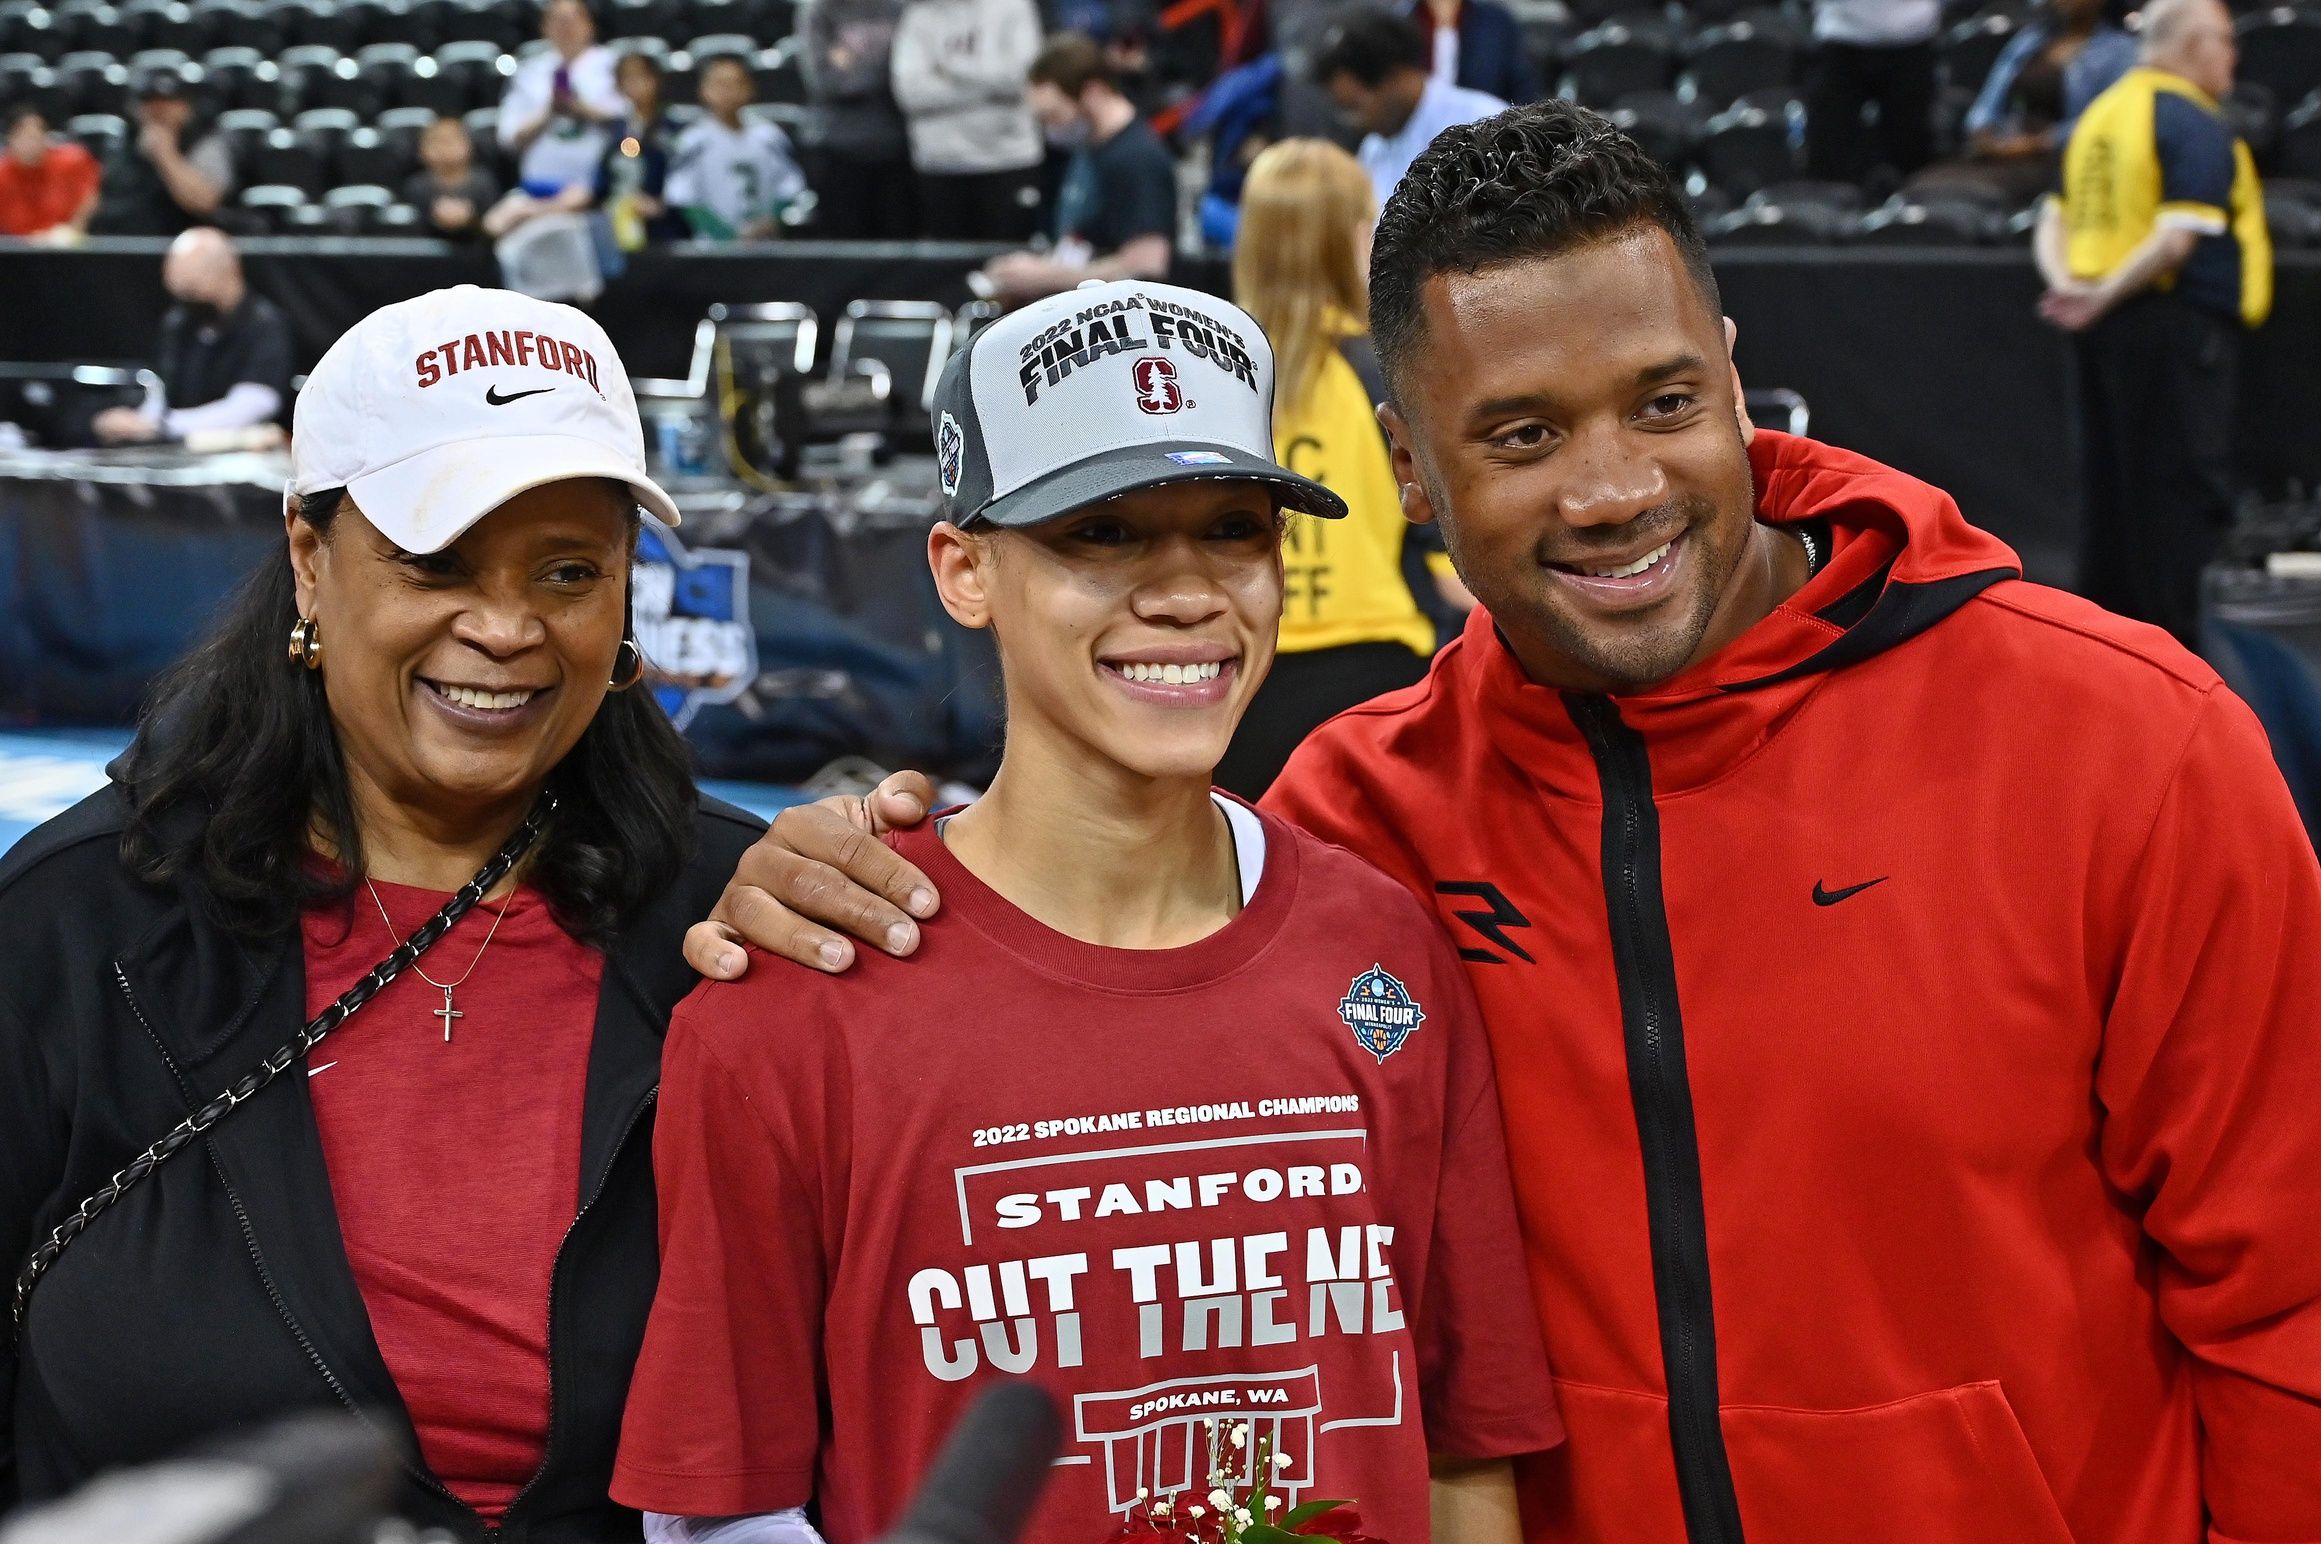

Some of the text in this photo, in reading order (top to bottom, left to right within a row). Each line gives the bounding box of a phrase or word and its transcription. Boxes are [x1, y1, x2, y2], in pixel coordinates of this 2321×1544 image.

[415, 330, 600, 394] STANFORD
[1019, 312, 1258, 407] FINAL FOUR
[1020, 318, 1074, 364] 2022
[1145, 298, 1246, 349] WOMEN'S
[1344, 1003, 1414, 1025] FINAL FOUR
[972, 1094, 1360, 1148] 2022 SPOKANE REGIONAL CHAMPIONS
[995, 1163, 1362, 1229] STANFORD
[907, 1252, 1089, 1382] CUT
[1112, 1231, 1297, 1359] THE
[1129, 1387, 1290, 1421] SPOKANE, WA
